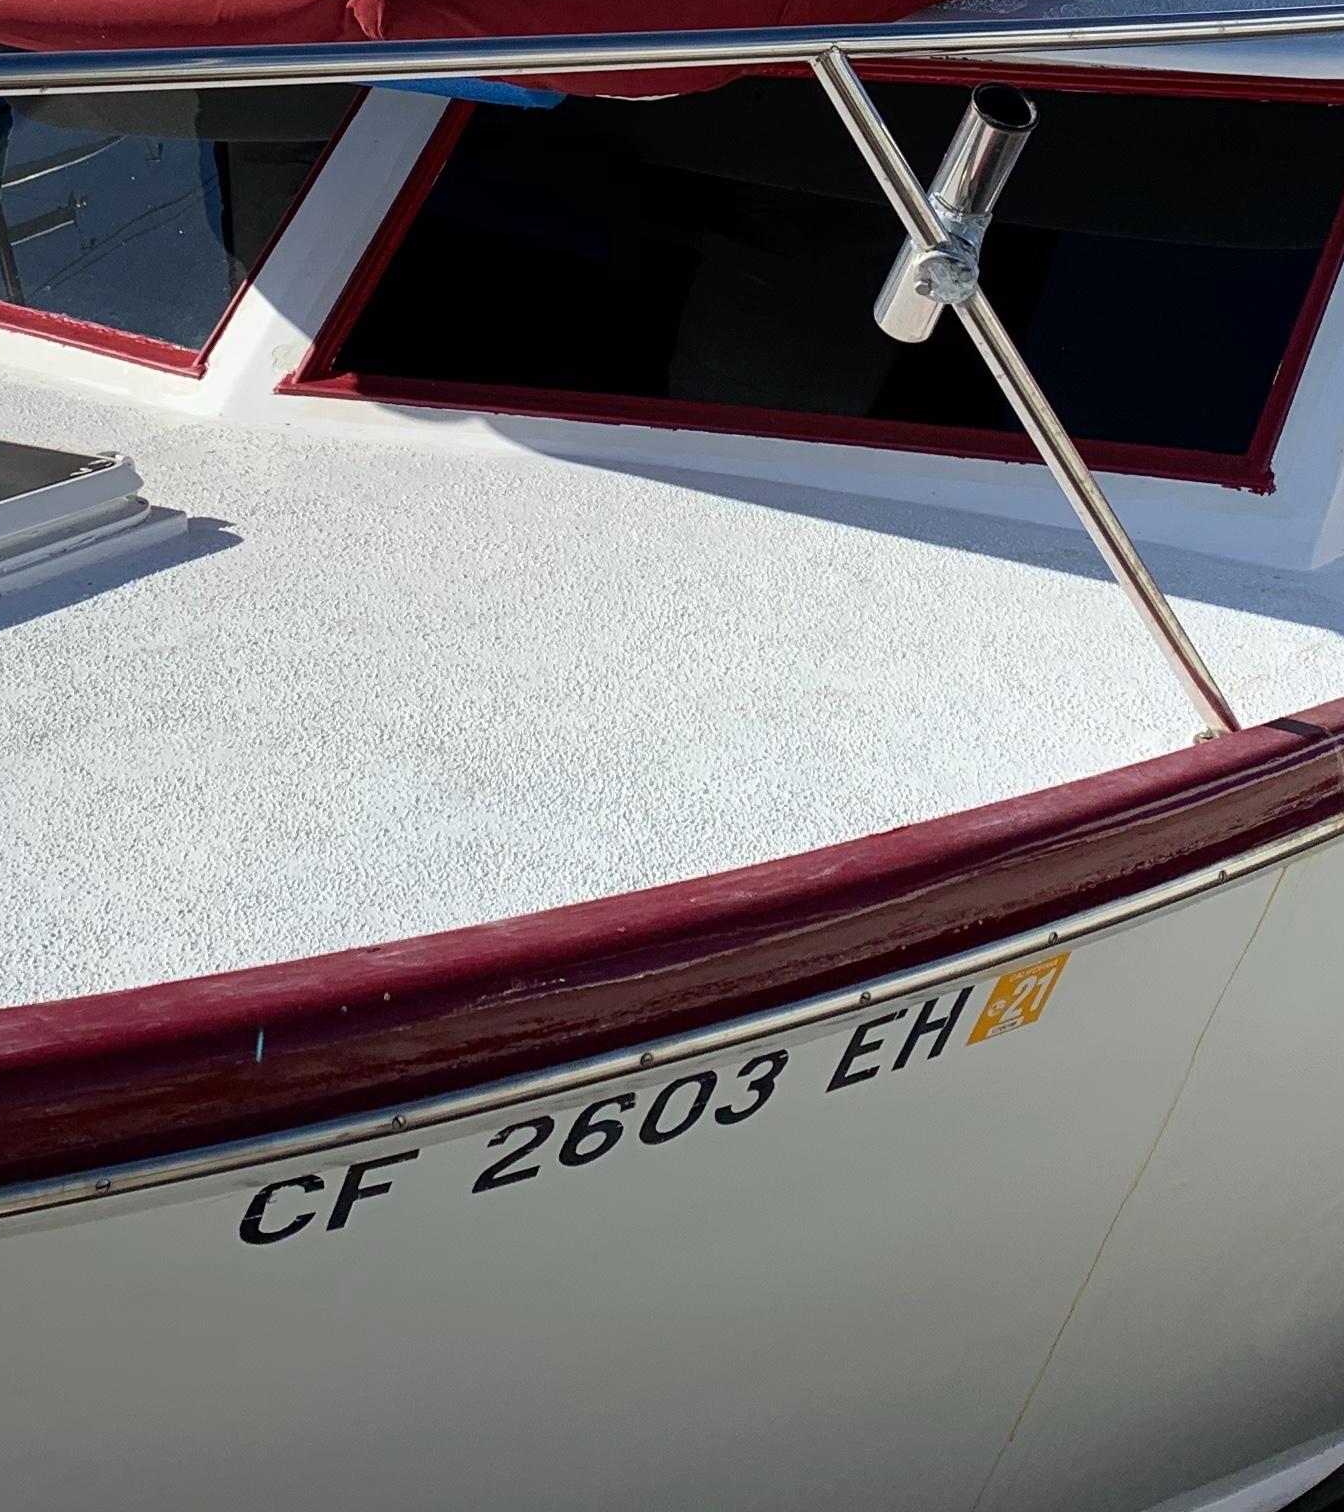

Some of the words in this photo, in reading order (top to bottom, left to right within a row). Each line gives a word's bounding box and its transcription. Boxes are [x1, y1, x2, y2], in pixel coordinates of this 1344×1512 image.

[999, 968, 1057, 1024] 21
[239, 1149, 420, 1246] CF
[471, 1049, 789, 1194] 2603
[825, 985, 975, 1093] EH
